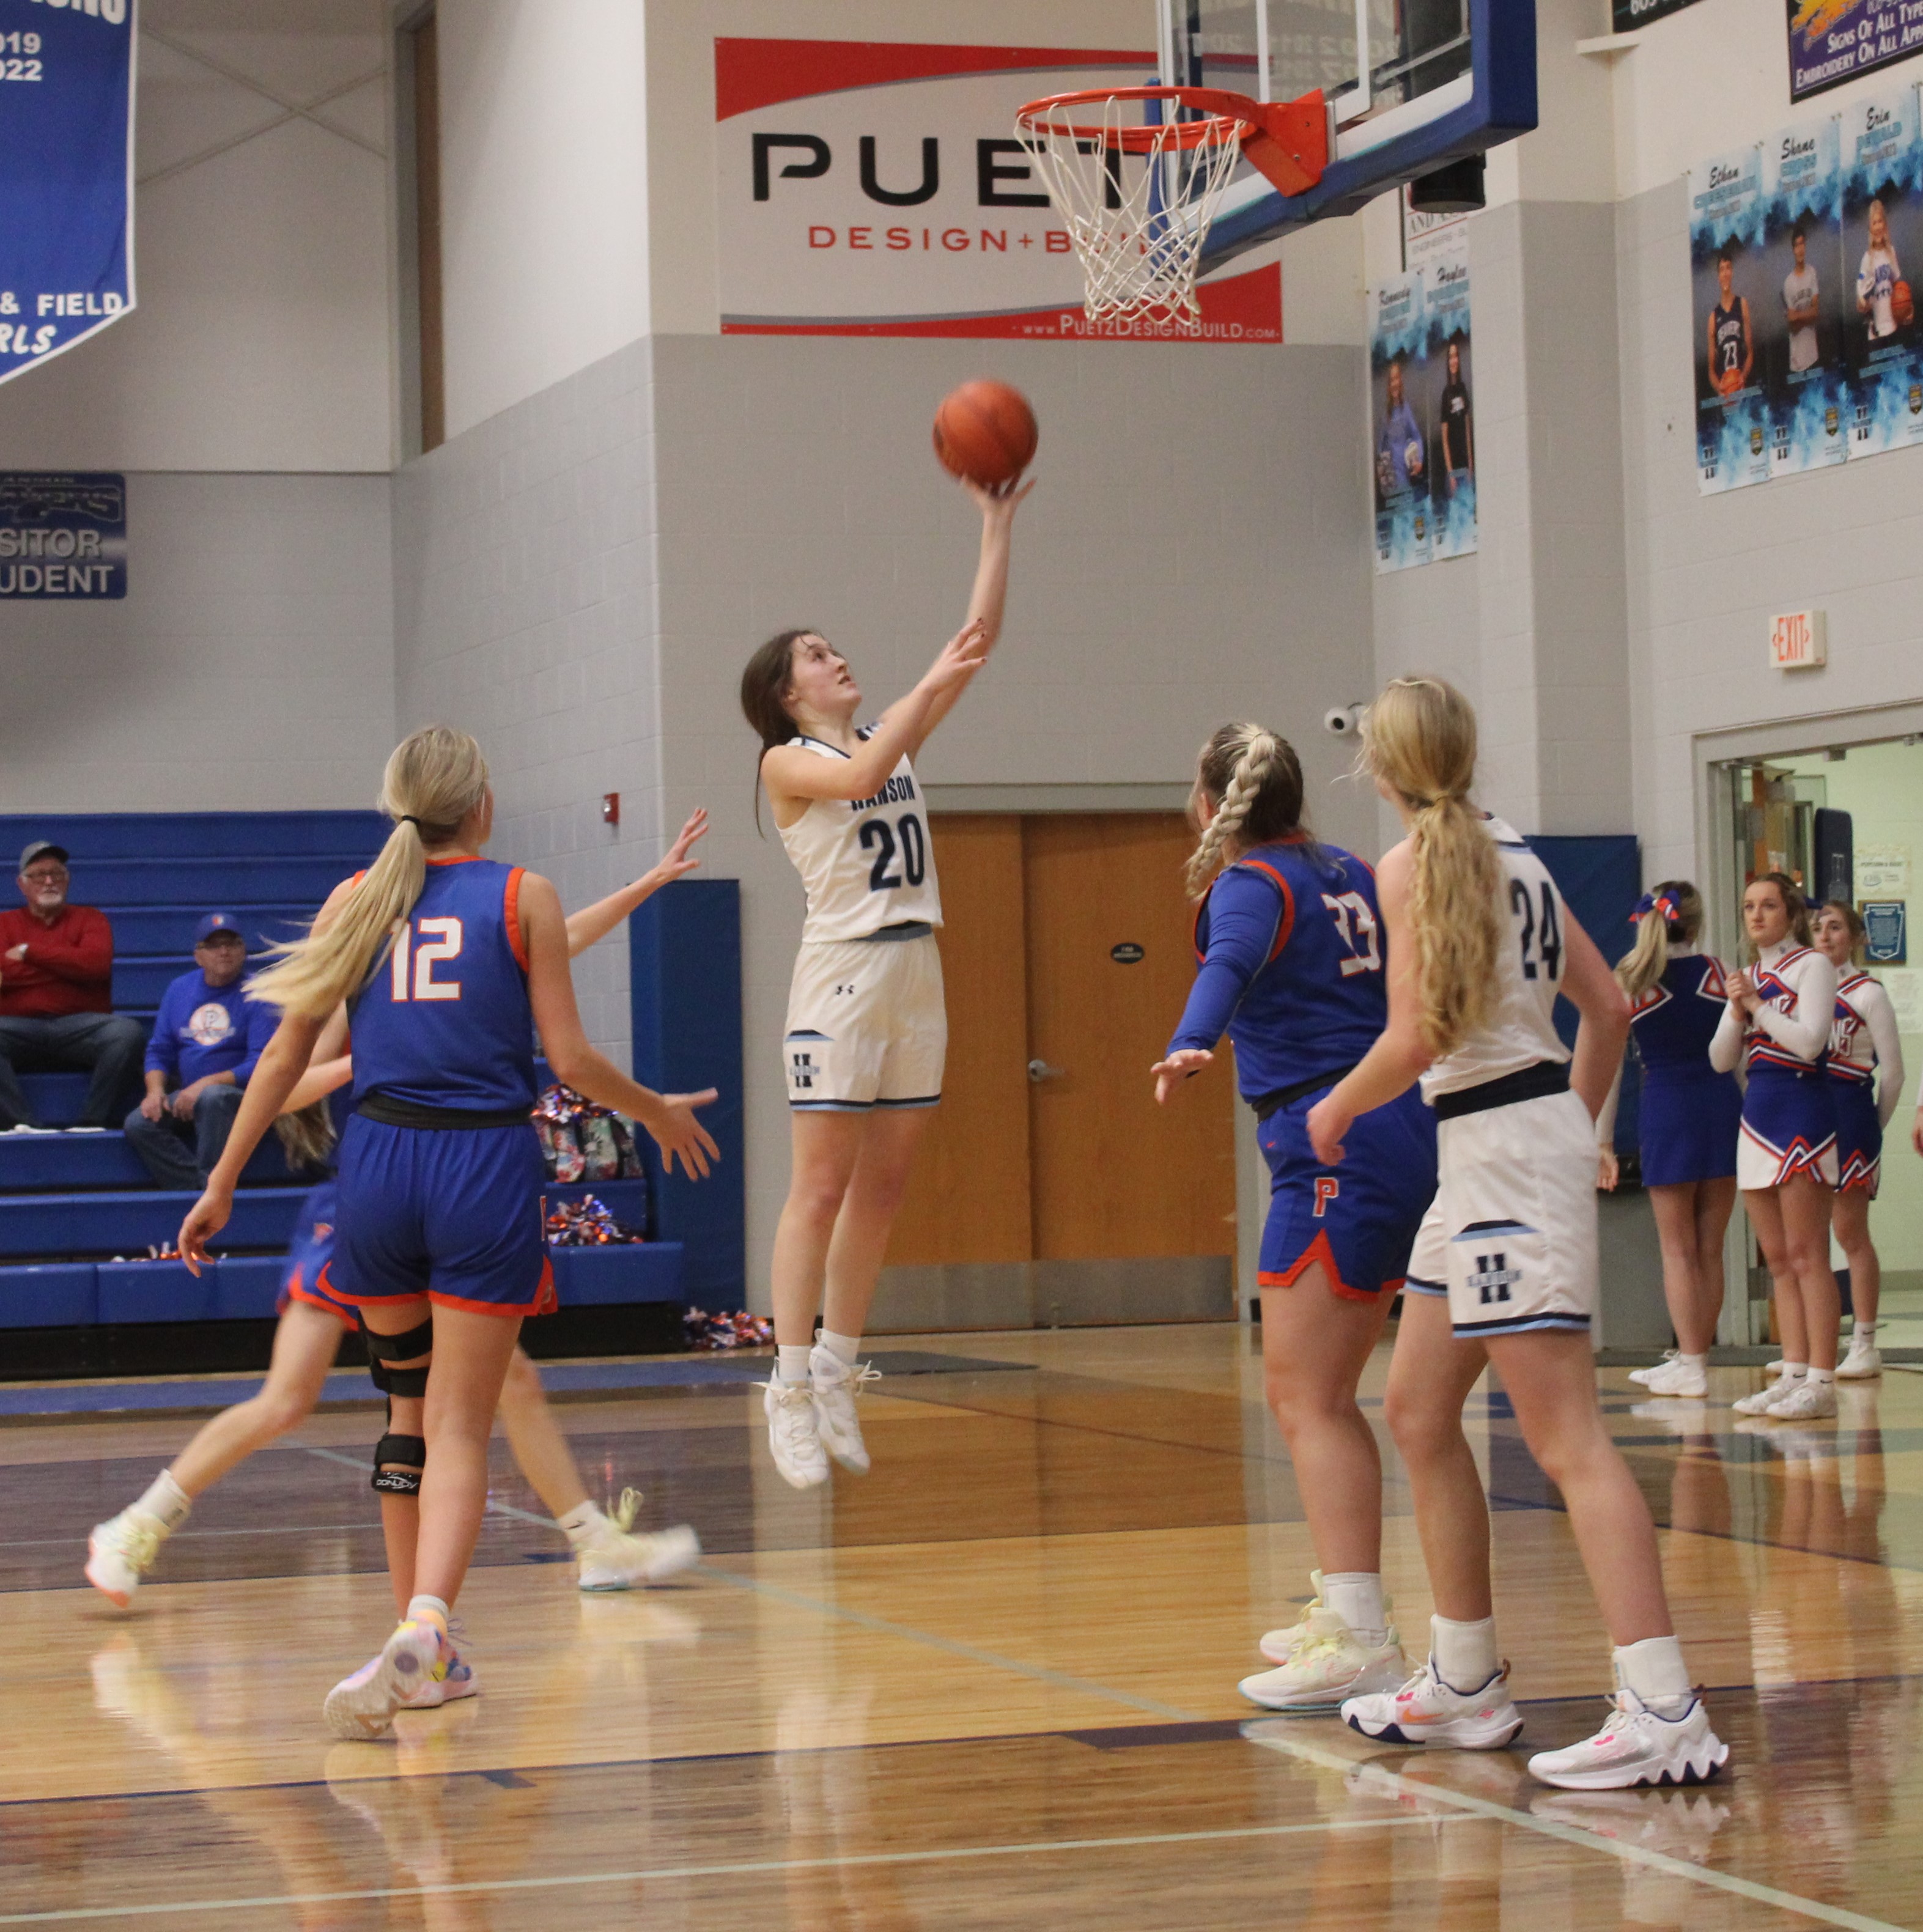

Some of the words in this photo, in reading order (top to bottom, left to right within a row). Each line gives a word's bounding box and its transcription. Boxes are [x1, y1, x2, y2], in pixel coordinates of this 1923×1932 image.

[752, 133, 1147, 209] PUET
[37, 292, 122, 317] FIELD
[0, 528, 100, 558] SITOR
[0, 565, 114, 593] UDENT
[1777, 614, 1806, 662] EXIT
[860, 813, 925, 891] 20
[1510, 878, 1561, 981] 24
[389, 916, 463, 1002] 12
[1312, 1177, 1340, 1217] P
